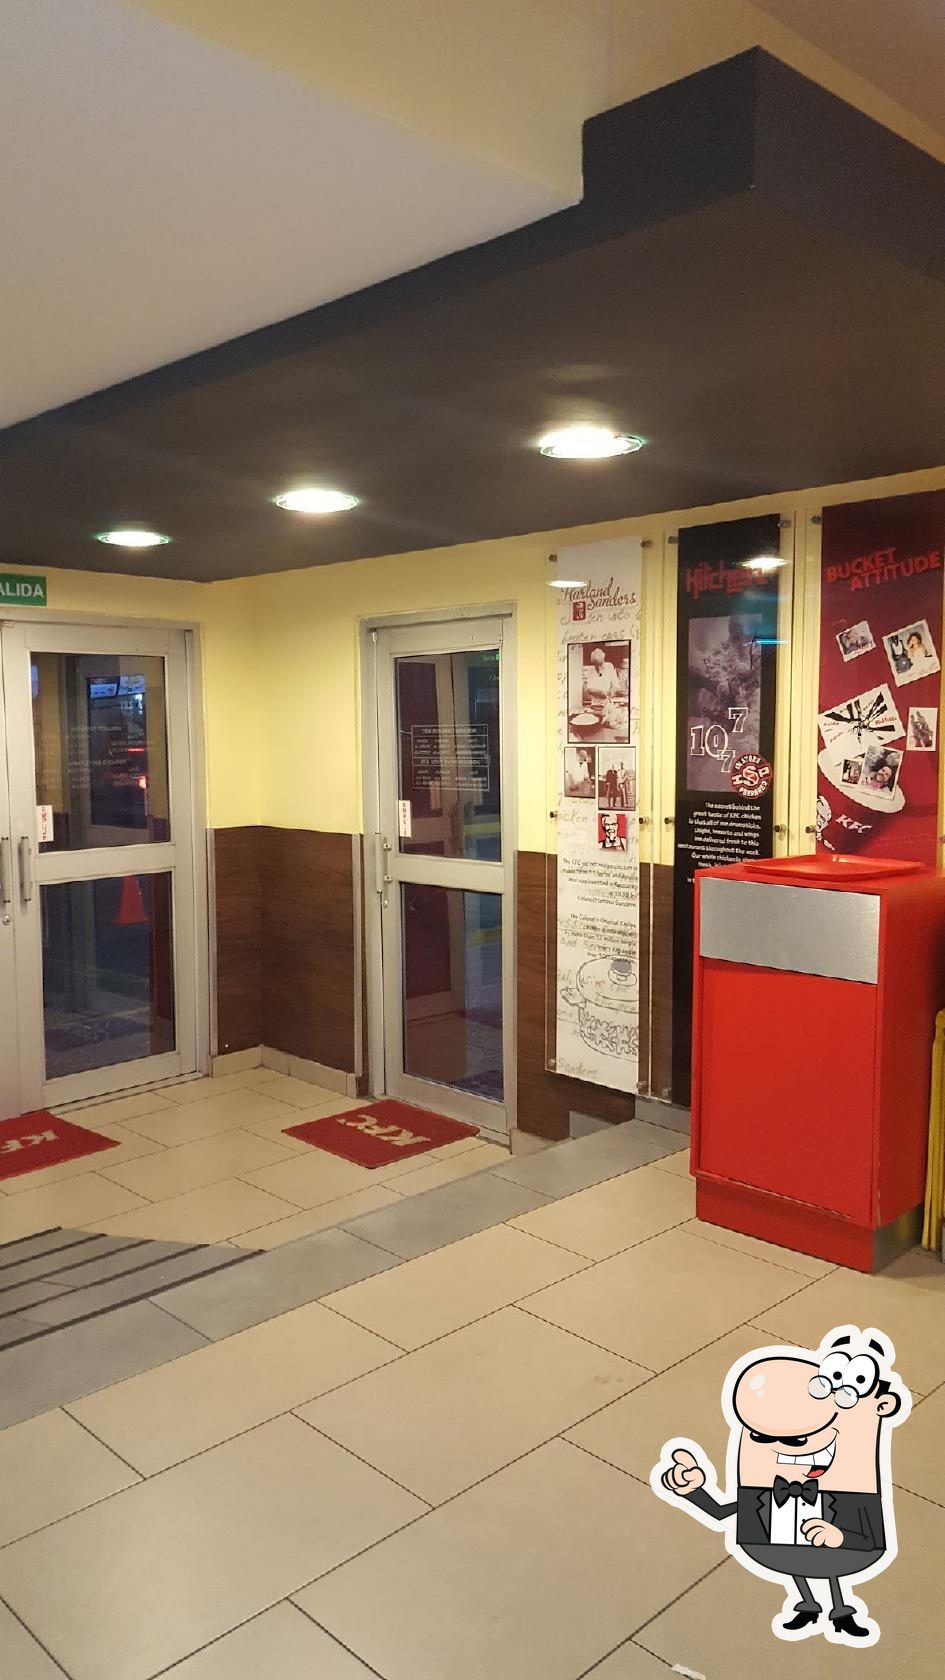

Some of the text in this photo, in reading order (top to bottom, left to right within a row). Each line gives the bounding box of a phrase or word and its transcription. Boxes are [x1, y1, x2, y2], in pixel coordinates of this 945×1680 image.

[825, 546, 897, 583] BUCKET
[850, 549, 941, 592] ATTITUDE
[560, 576, 614, 602] Harland
[587, 586, 637, 610] Sanders
[740, 755, 761, 765] STORE
[738, 780, 768, 797] PREPARED
[732, 803, 750, 811] behind
[835, 814, 873, 834] KFC
[702, 836, 726, 844] delivered
[748, 839, 760, 847] this
[335, 1113, 433, 1147] KFC
